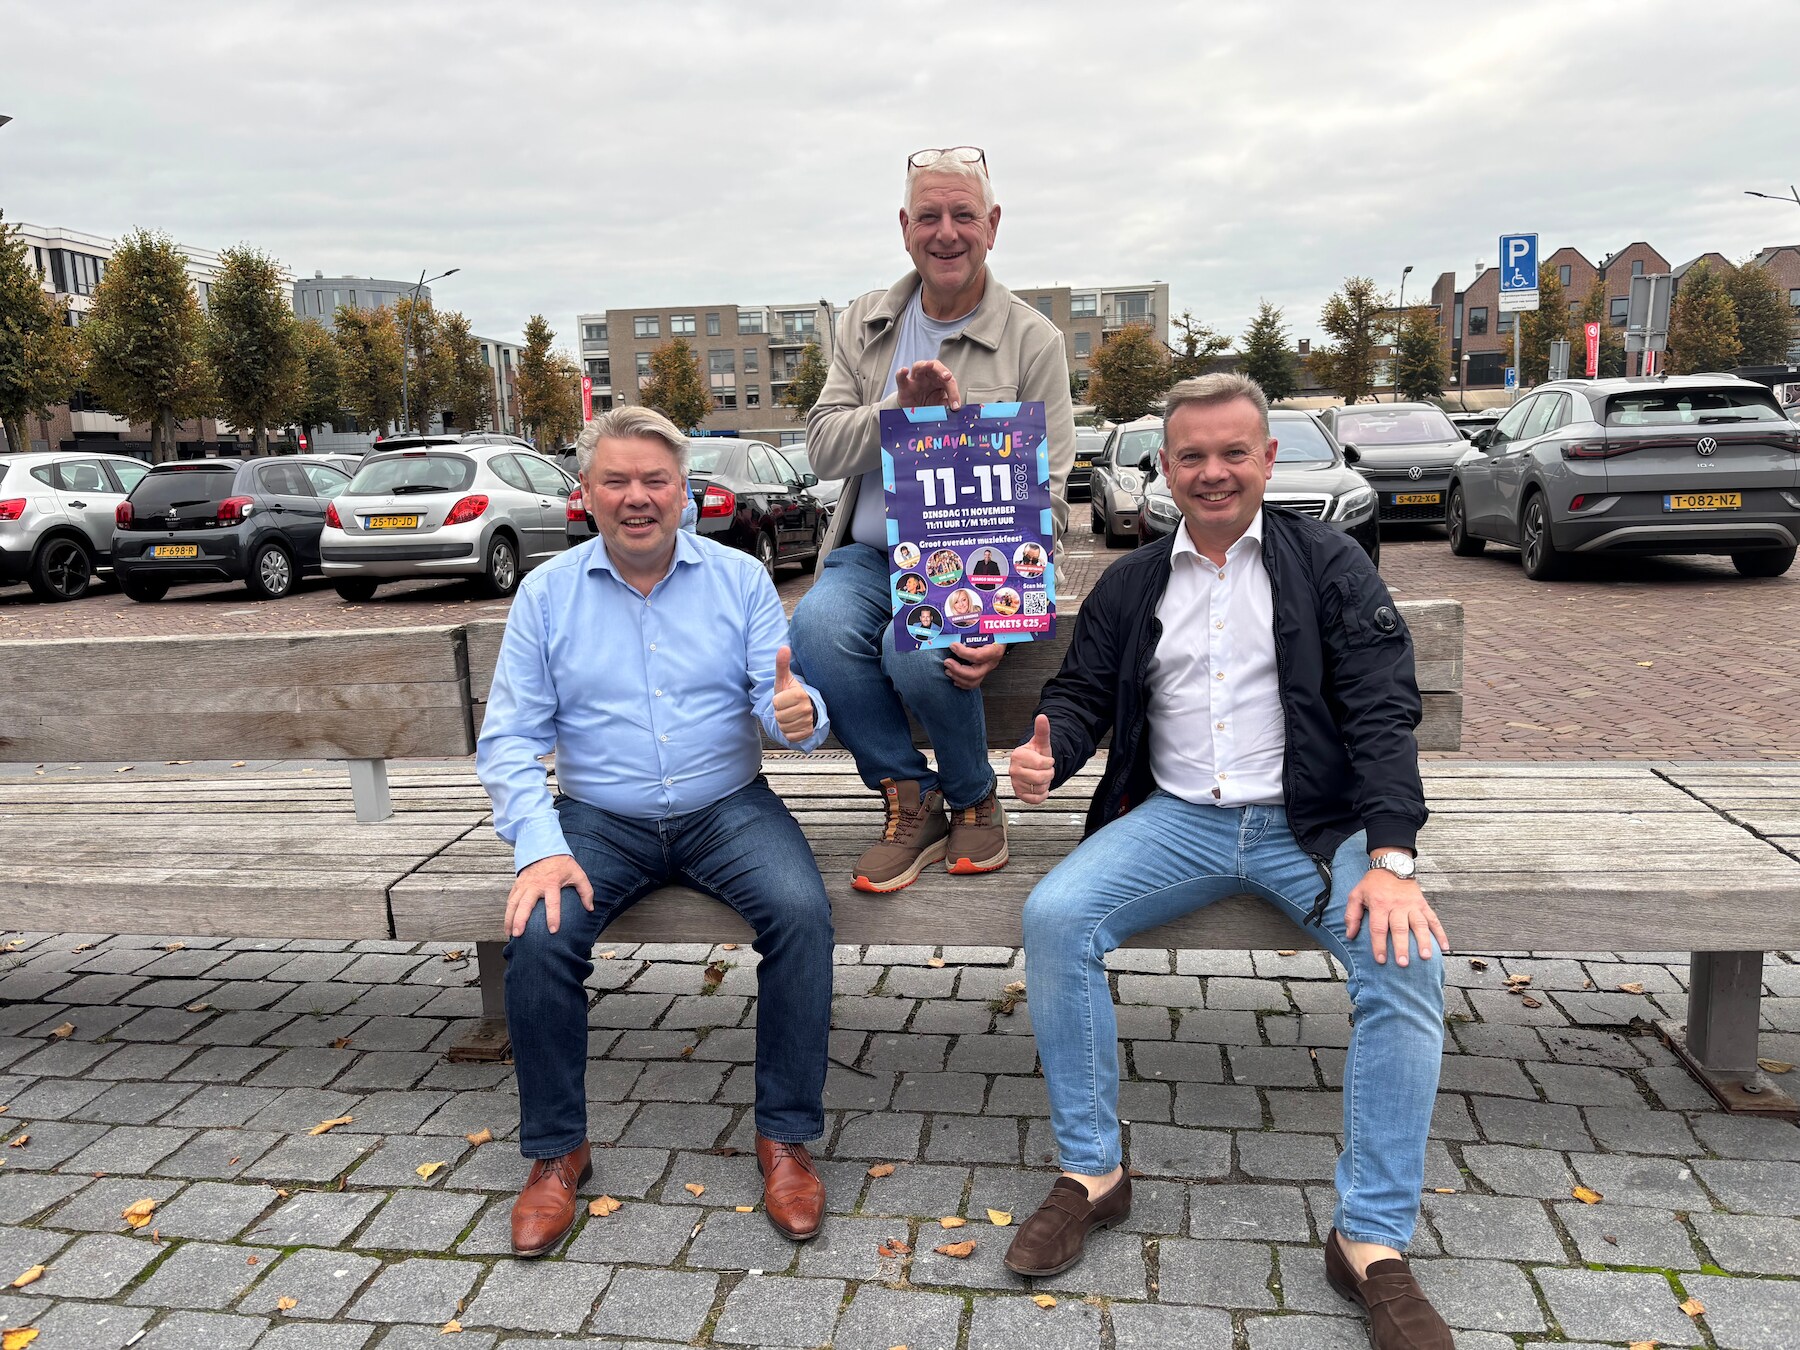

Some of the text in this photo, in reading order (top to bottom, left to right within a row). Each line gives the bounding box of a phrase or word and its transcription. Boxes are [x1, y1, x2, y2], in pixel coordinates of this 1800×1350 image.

[1509, 239, 1530, 268] P
[1508, 370, 1515, 380] P
[908, 433, 975, 452] CARNAVAL
[991, 431, 1024, 458] UJE
[916, 464, 1012, 506] 11-11
[1014, 464, 1029, 501] 2025
[1675, 494, 1737, 507] T-082-NZ
[922, 506, 1016, 519] DINSDAG 11 NOVEMBER
[372, 517, 413, 527] 25-TD-JD
[943, 520, 960, 528] UUR
[961, 518, 978, 527] T/M
[997, 516, 1014, 525] UUR
[919, 540, 941, 549] Groot
[942, 537, 977, 547] overdekt
[157, 546, 194, 556] JF-698-R
[984, 619, 1022, 629] TICKETS
